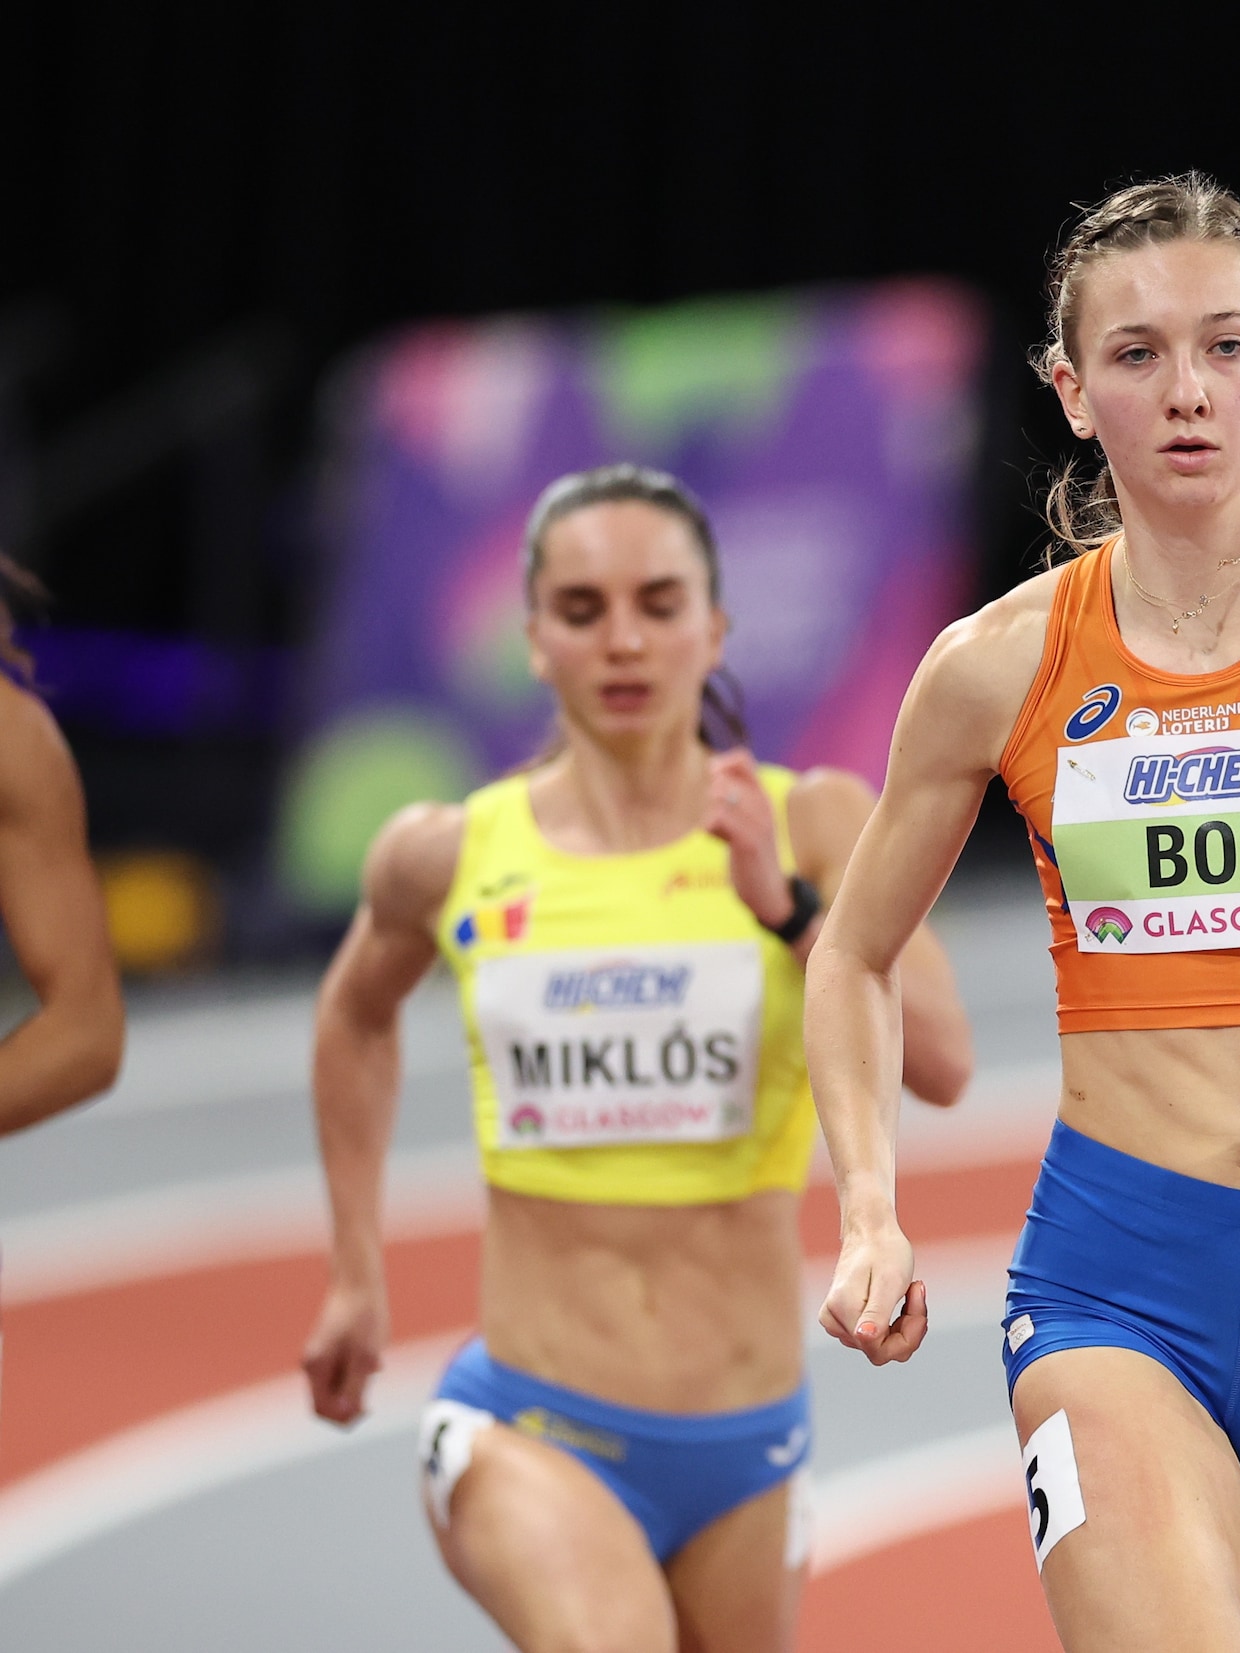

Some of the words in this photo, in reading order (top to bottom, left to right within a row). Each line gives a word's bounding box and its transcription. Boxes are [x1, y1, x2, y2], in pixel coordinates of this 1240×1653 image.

[1161, 717, 1230, 736] LOTERIJ
[510, 1022, 739, 1089] MIKLÓS
[1026, 1454, 1049, 1552] 5
